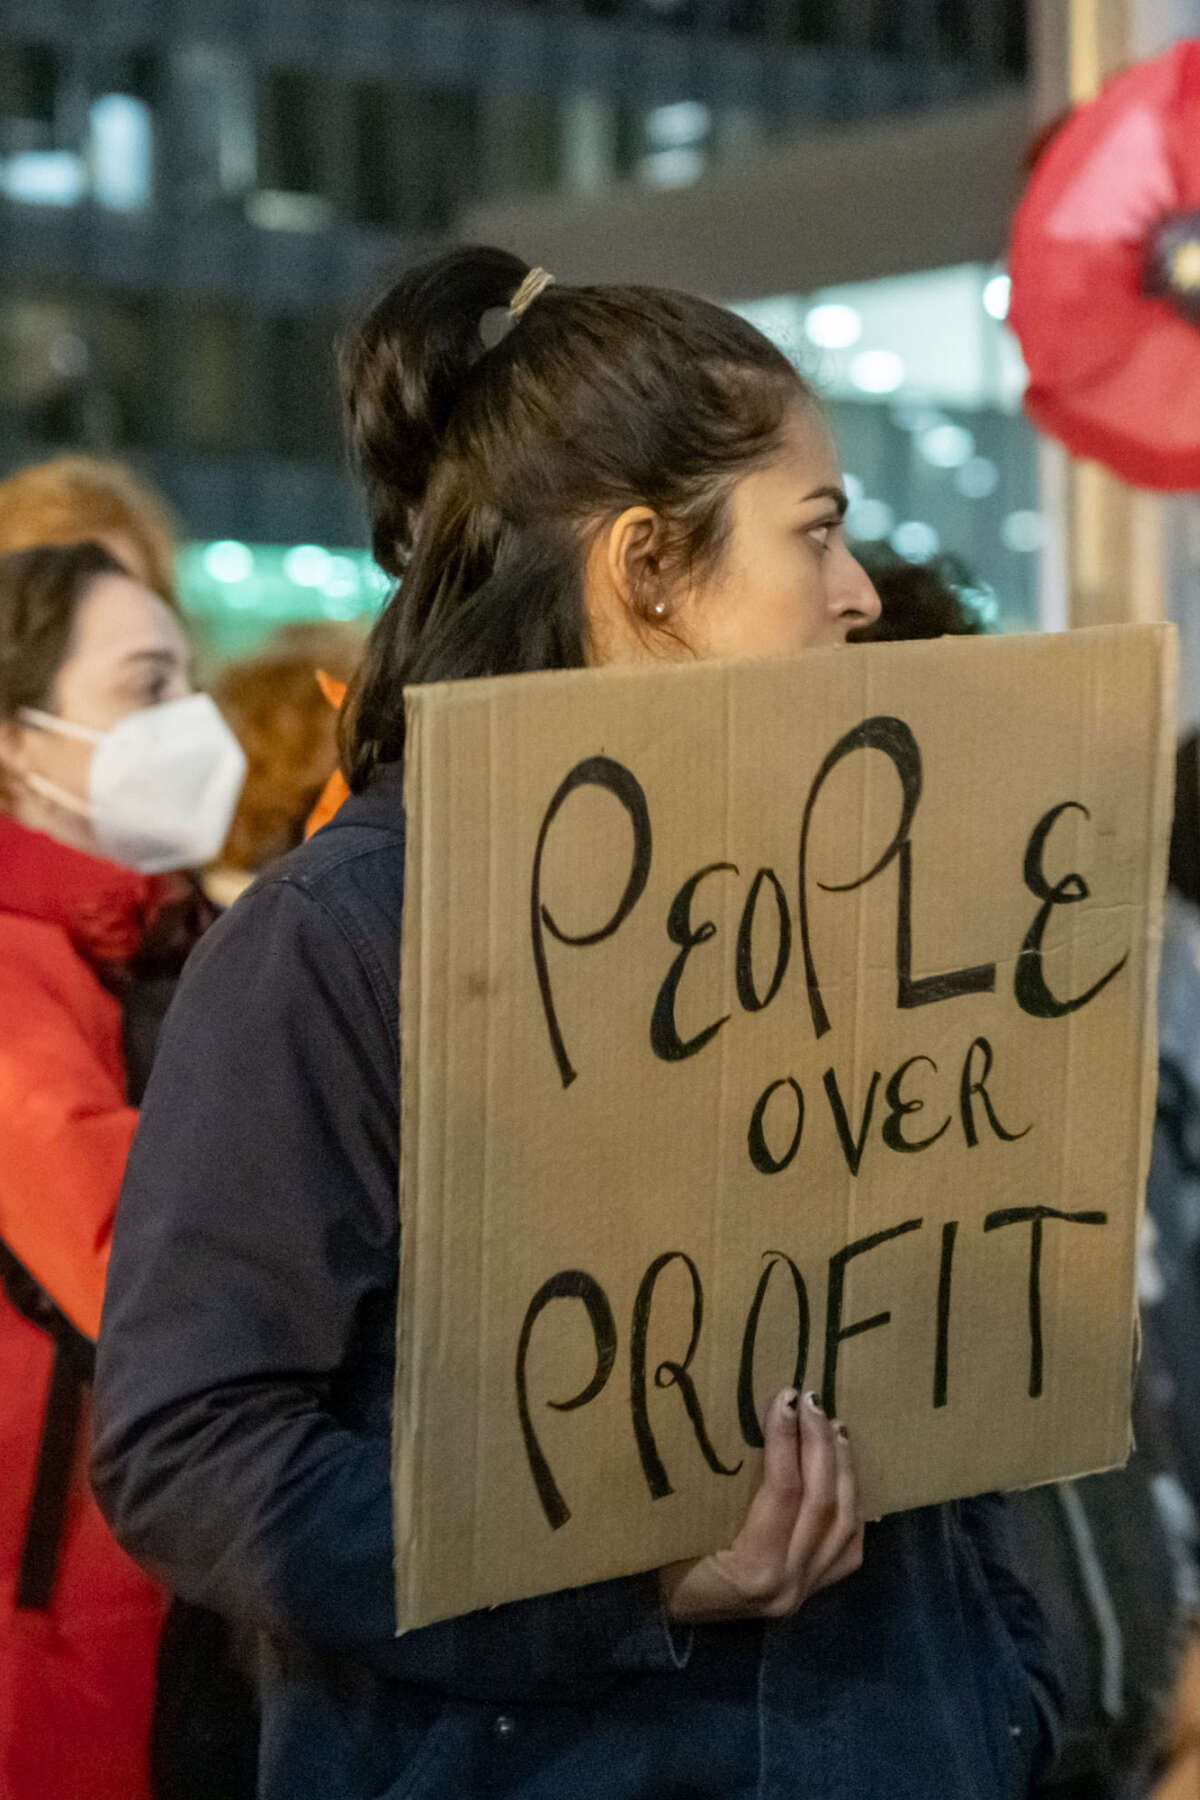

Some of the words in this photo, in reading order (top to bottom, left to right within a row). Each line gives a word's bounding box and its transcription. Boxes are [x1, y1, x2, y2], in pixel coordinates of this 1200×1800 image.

[531, 715, 1128, 1089] PEOPLE
[747, 1036, 1032, 1177] OVER
[514, 1204, 1108, 1531] PROFIT
